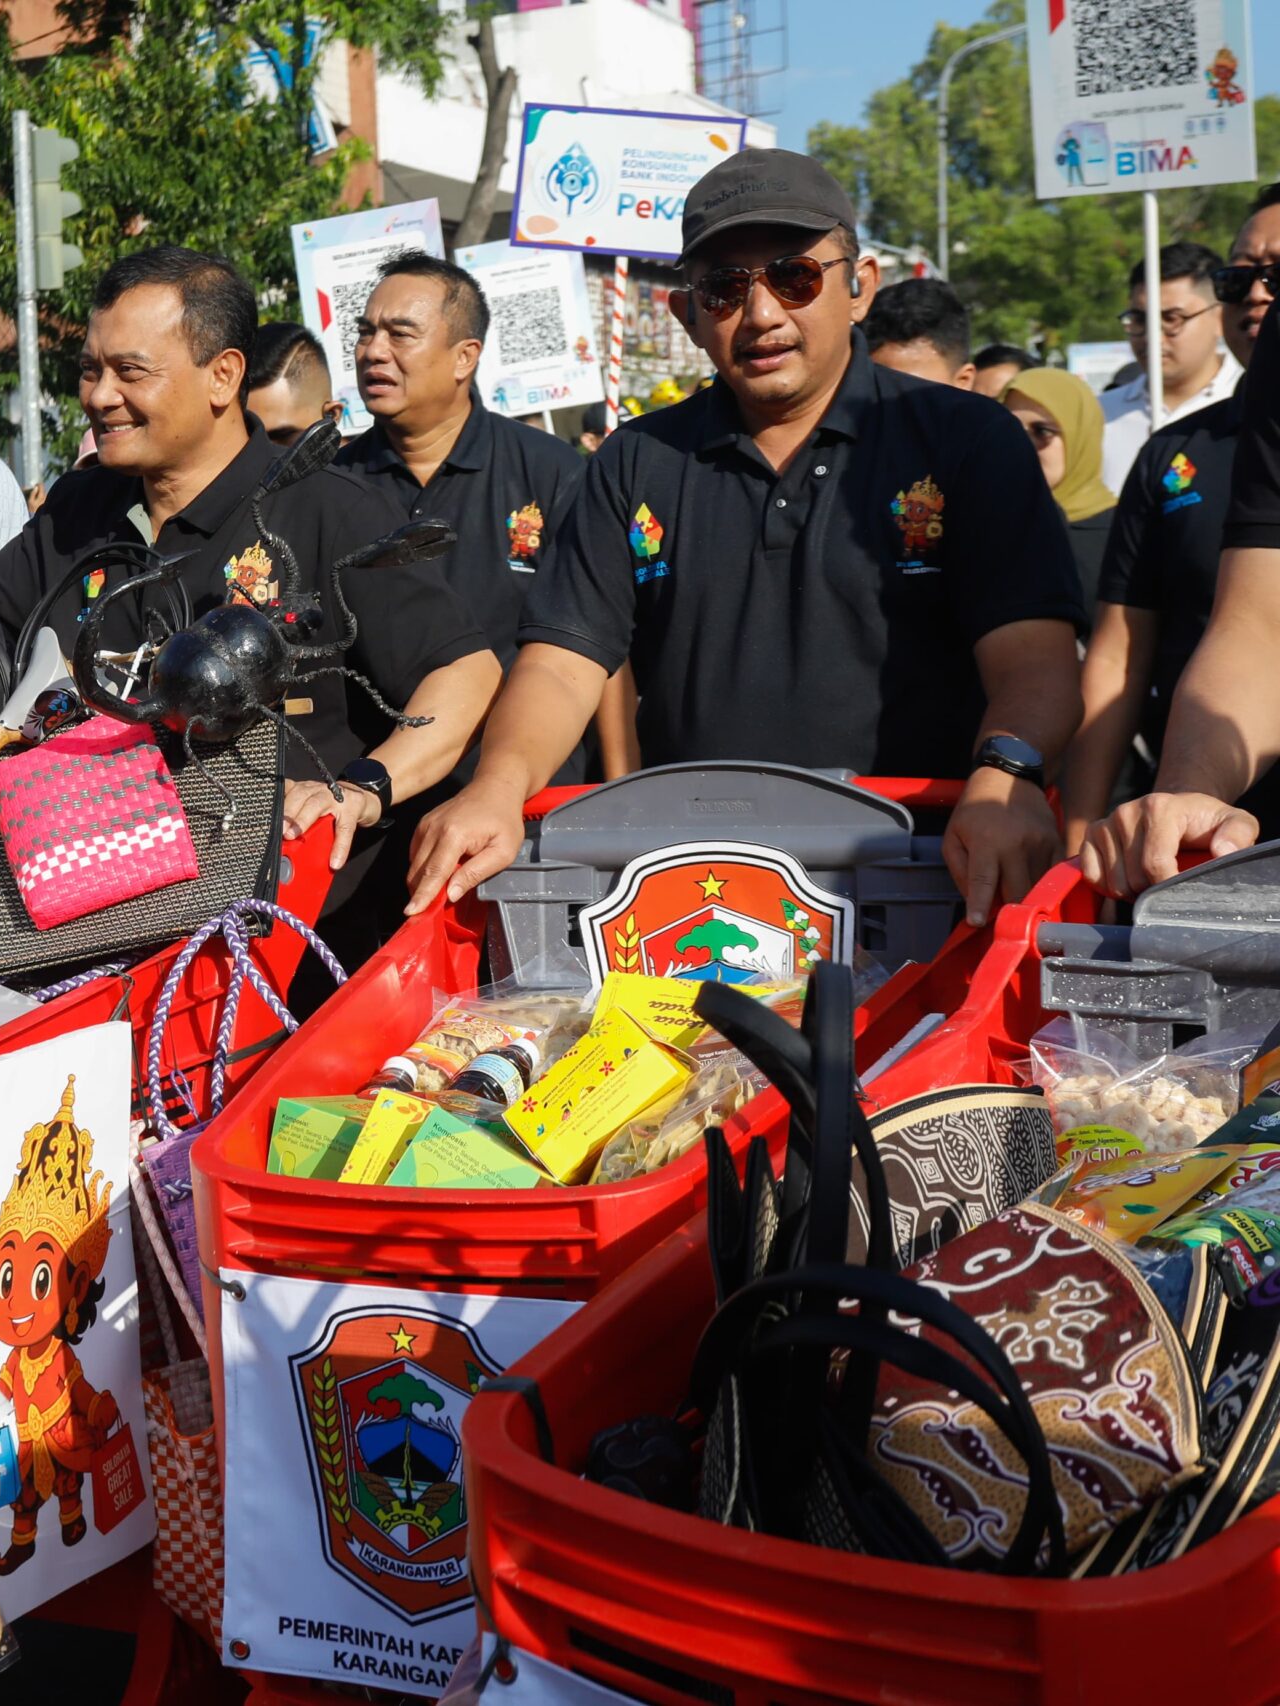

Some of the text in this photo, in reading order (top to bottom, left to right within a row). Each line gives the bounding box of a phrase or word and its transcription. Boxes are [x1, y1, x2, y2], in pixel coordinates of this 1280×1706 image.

[622, 159, 687, 172] KONSUMEN
[623, 148, 708, 161] PELINDUNGAN
[1116, 146, 1195, 176] BIMA
[621, 170, 652, 180] BANK
[527, 386, 570, 404] BIMA
[1226, 1212, 1269, 1251] Original
[1230, 1245, 1258, 1285] Pedas
[102, 1443, 131, 1476] SOLORAYA
[107, 1460, 132, 1494] GREAT
[113, 1482, 134, 1511] SALE
[363, 1544, 456, 1578] KARANGANYAR
[279, 1616, 414, 1657] PEMERINTAH
